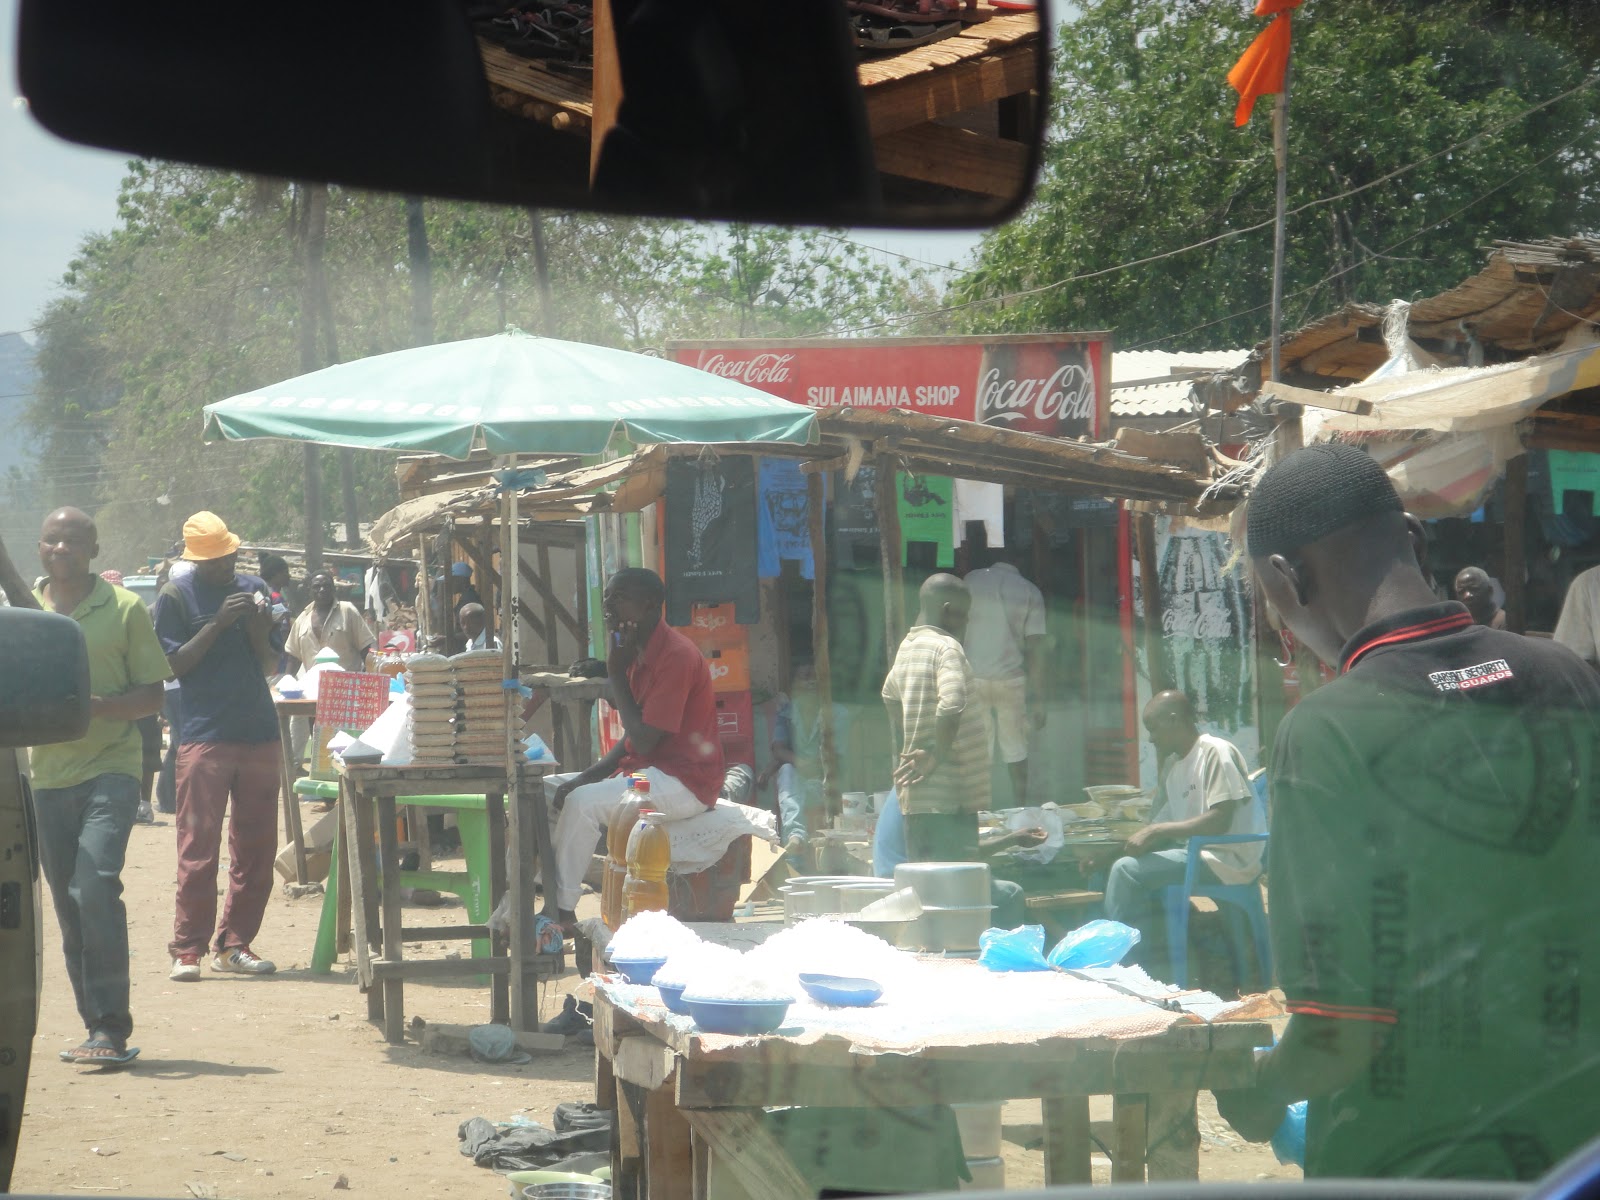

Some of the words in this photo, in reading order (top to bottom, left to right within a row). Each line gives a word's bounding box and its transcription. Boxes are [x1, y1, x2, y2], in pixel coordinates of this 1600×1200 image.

[703, 353, 796, 383] Coca-Cola
[807, 386, 912, 407] SULAIMANA
[915, 385, 960, 406] SHOP
[975, 364, 1096, 424] Coca-Cola
[1460, 670, 1513, 688] GUARDS
[1465, 660, 1509, 680] SECURITY
